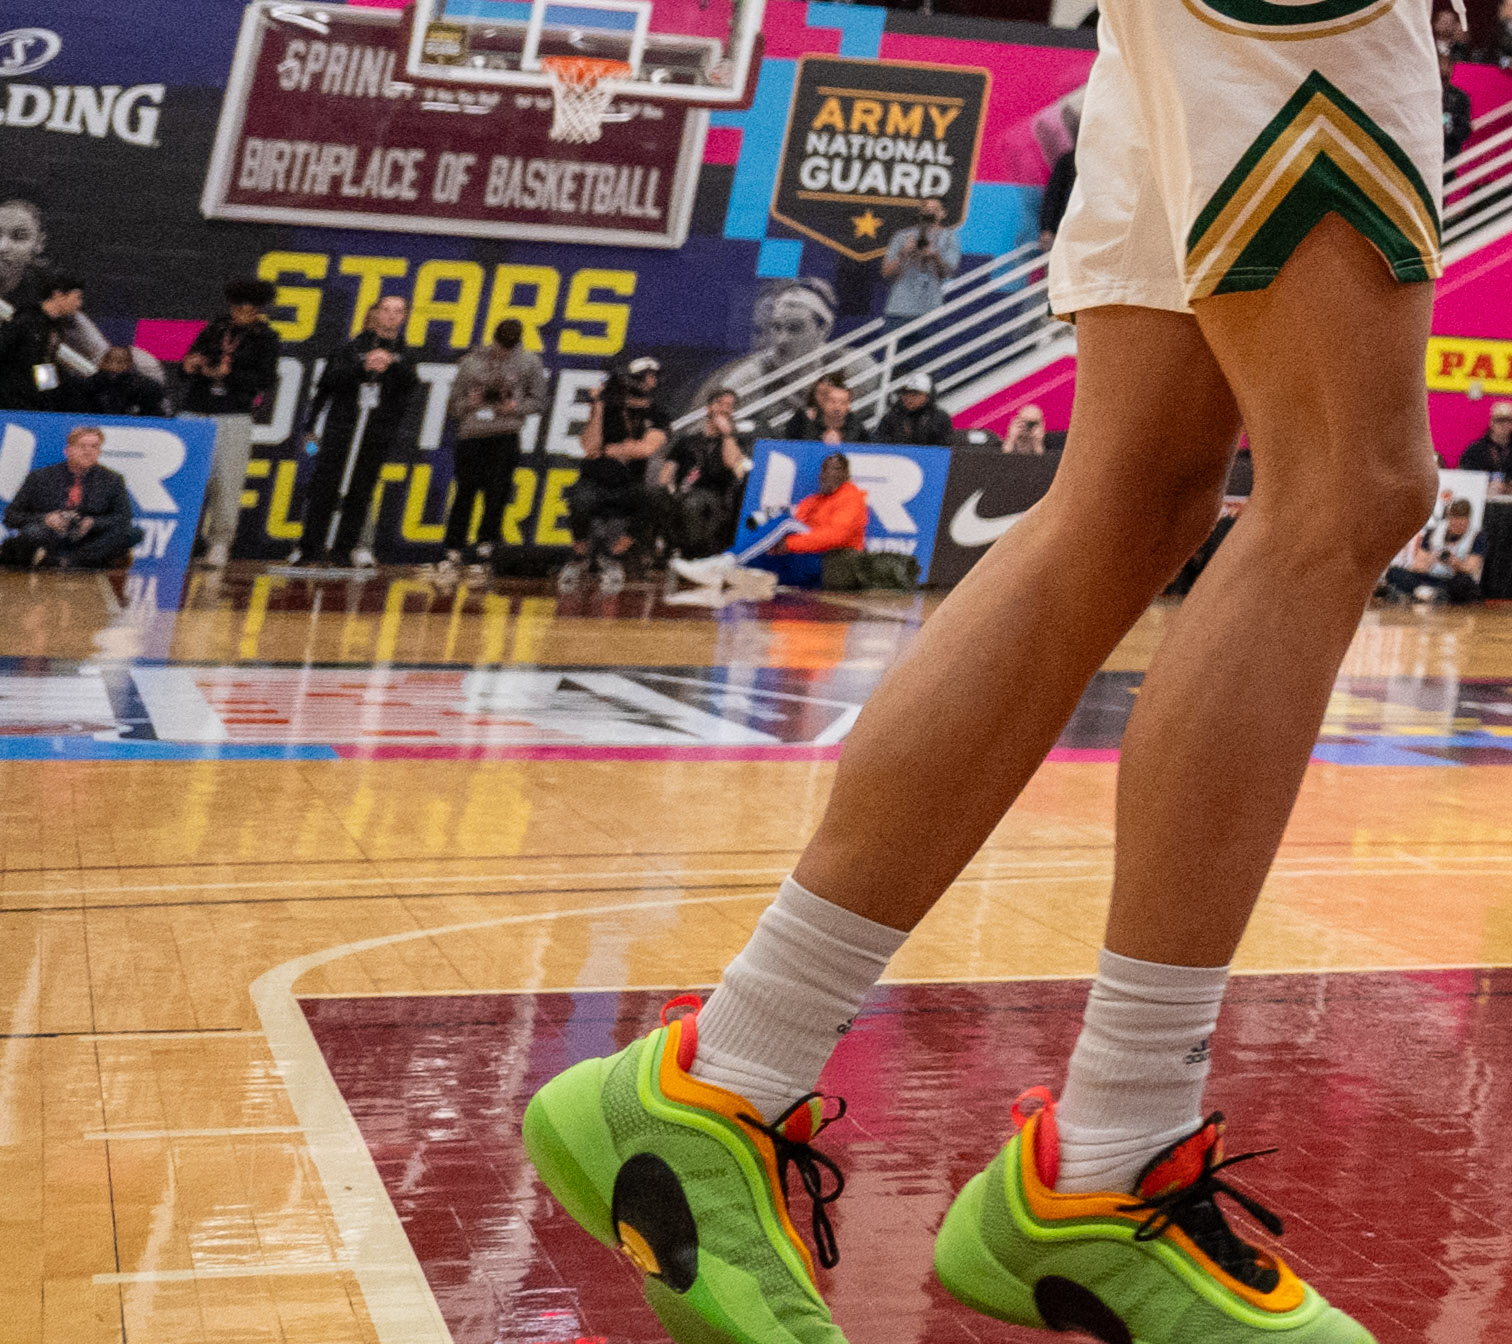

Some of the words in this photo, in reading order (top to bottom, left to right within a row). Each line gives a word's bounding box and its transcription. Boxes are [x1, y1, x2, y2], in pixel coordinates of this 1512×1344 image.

[0, 82, 167, 148] DING
[812, 97, 961, 139] ARMY
[805, 130, 954, 167] NATIONAL
[238, 136, 426, 203] BIRTHPLACE
[432, 151, 478, 204] OF
[483, 154, 662, 219] BASKETBALL
[799, 155, 951, 198] GUARD
[257, 250, 637, 356] STARS
